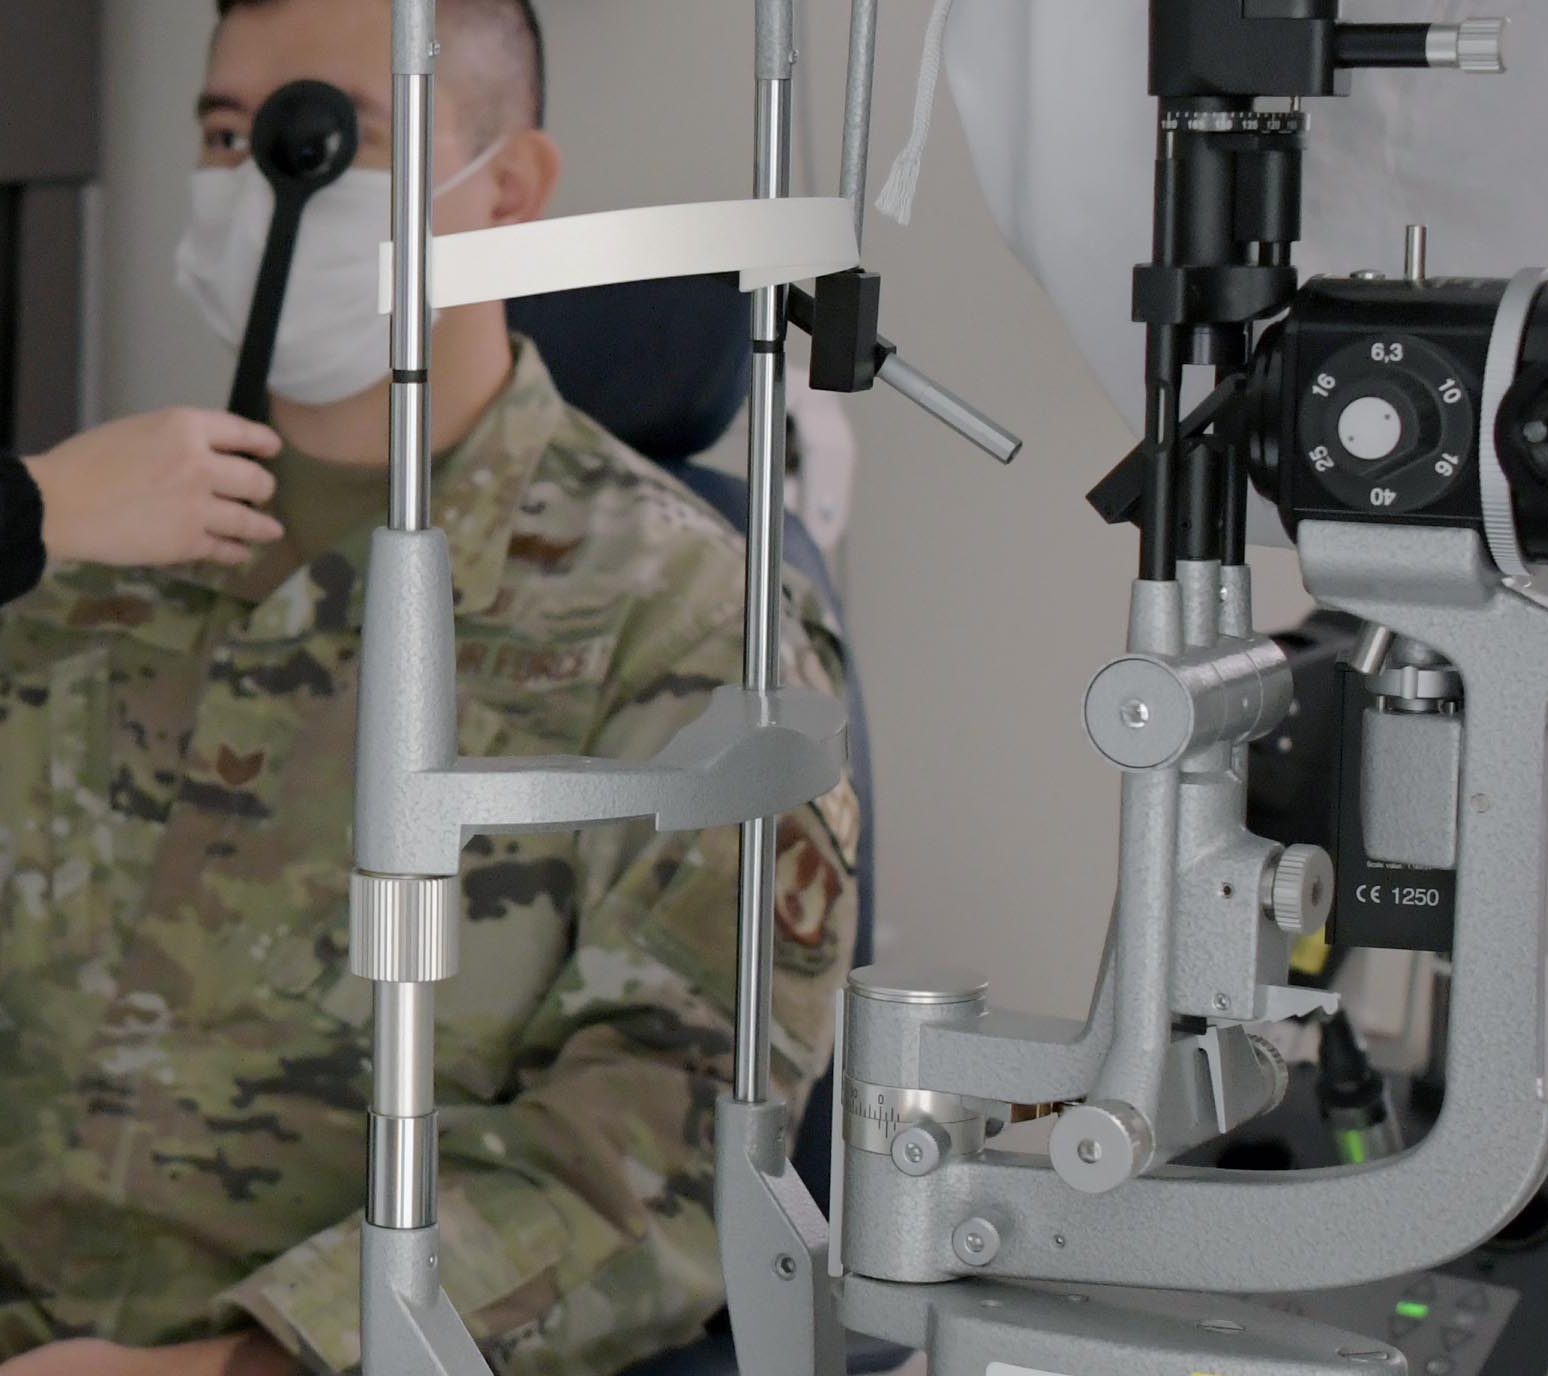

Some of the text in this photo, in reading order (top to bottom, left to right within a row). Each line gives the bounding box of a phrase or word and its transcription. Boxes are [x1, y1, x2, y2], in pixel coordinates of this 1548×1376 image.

[1371, 343, 1403, 364] 6,3
[1312, 373, 1336, 397] 16
[1438, 378, 1462, 404] 10
[1308, 445, 1335, 472] 25
[1434, 453, 1459, 477] 16
[1370, 488, 1397, 506] 40
[1356, 884, 1440, 906] CE 1250
[878, 1094, 884, 1104] 0
